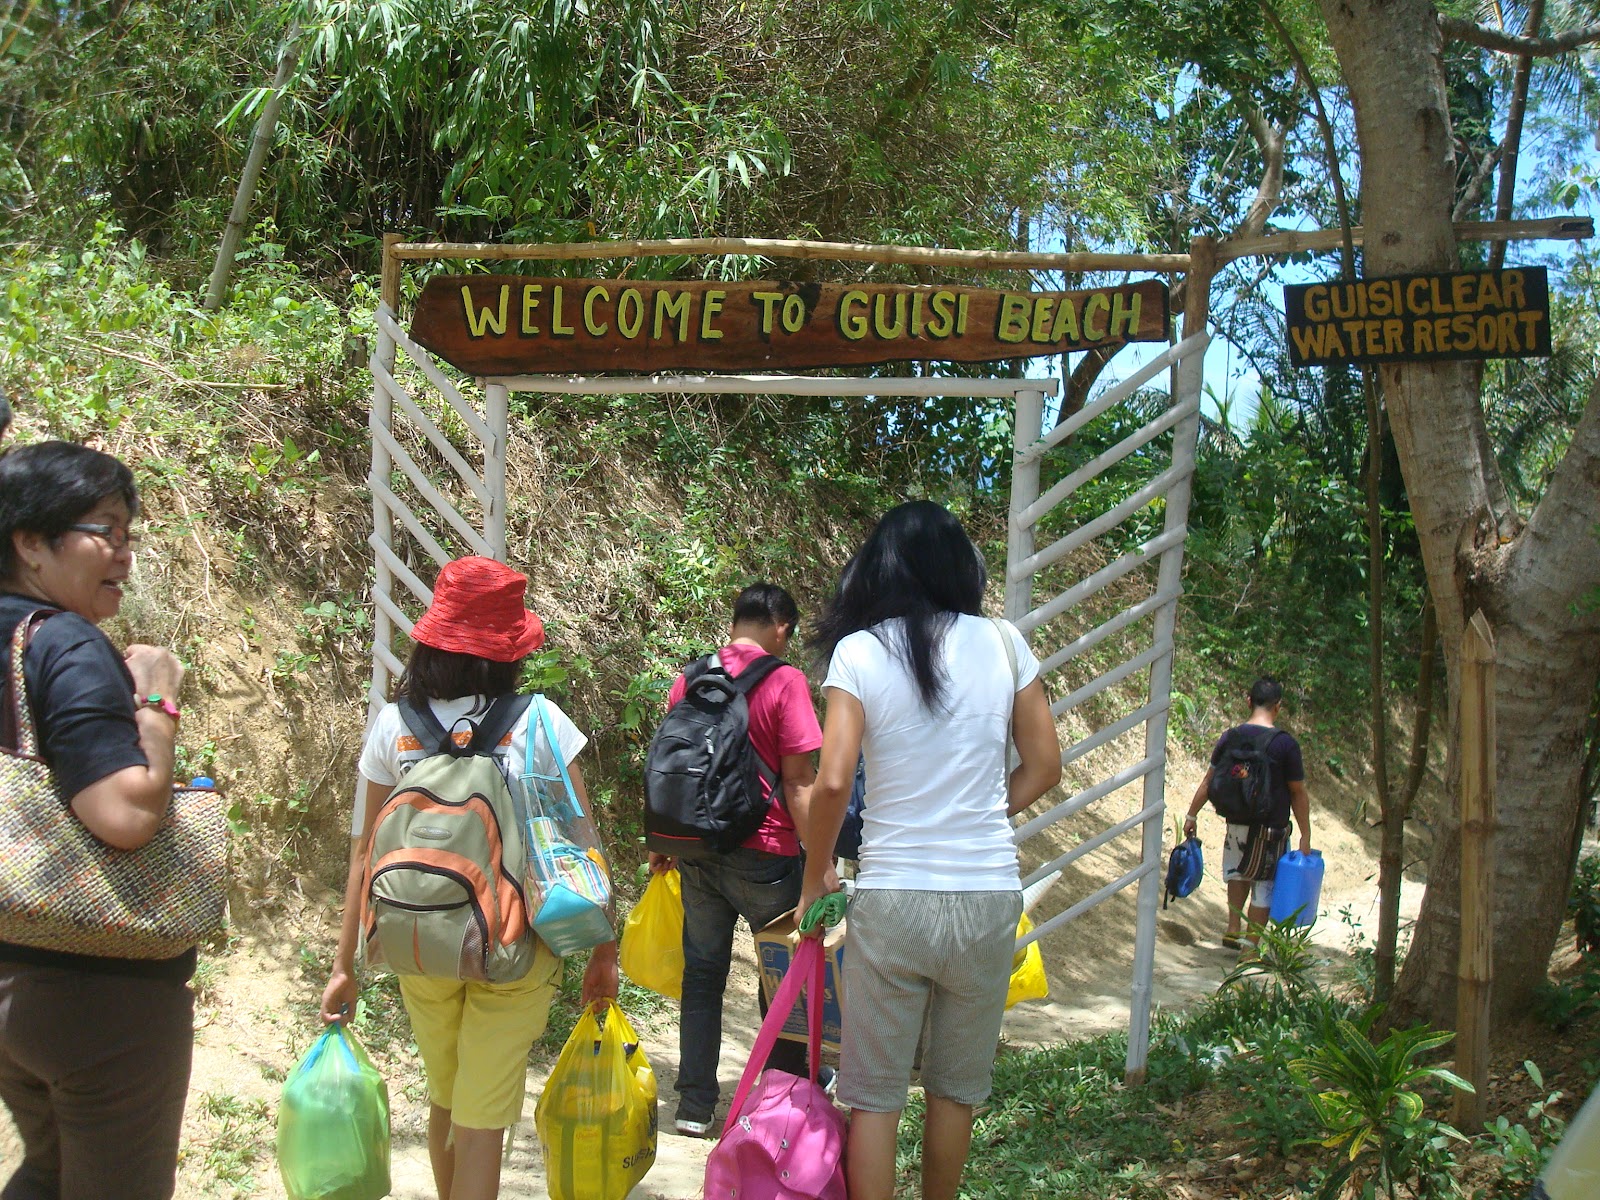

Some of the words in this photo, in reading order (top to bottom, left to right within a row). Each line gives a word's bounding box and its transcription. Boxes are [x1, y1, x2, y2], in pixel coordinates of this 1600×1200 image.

[461, 284, 726, 342] WELCOME
[753, 291, 806, 334] TO
[840, 290, 969, 340] GUISI
[998, 292, 1142, 343] BEACH
[1291, 319, 1405, 360] WATER
[1412, 310, 1543, 354] RESORT
